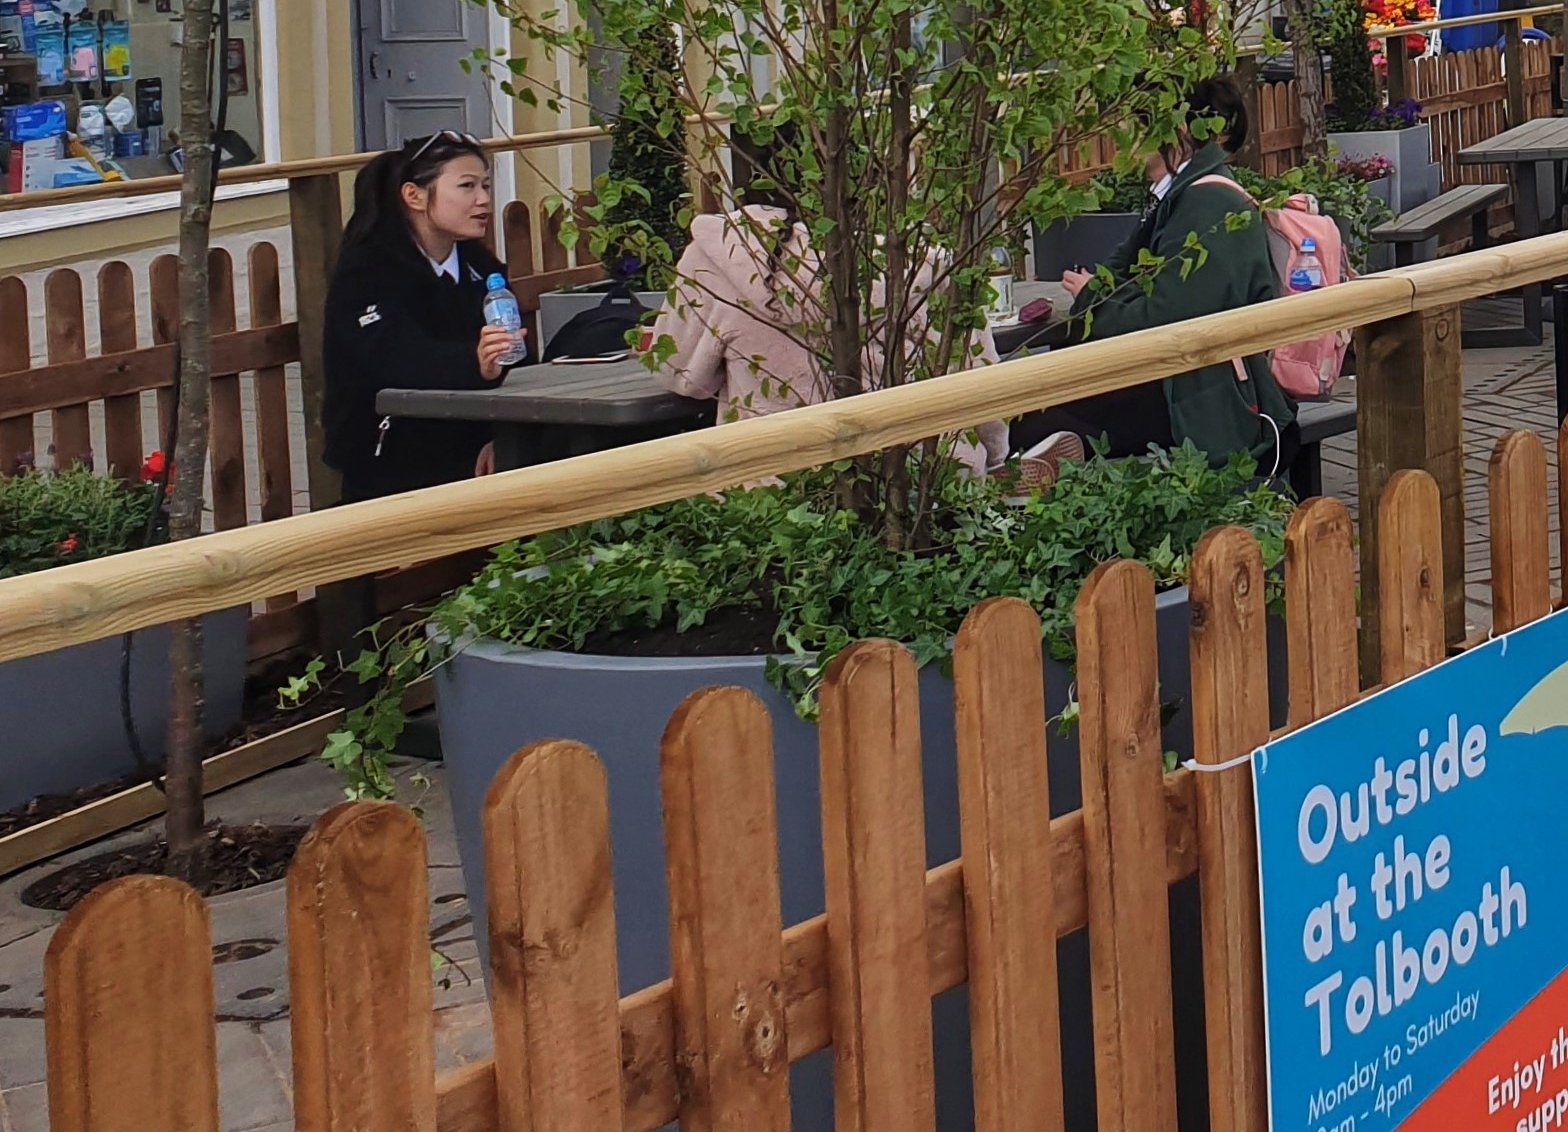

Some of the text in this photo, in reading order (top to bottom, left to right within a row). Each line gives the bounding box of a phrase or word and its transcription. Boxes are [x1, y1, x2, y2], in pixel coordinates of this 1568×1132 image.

[1297, 712, 1487, 864] Outside
[1303, 834, 1451, 963] at the
[1304, 865, 1527, 1057] Tolbooth
[1307, 989, 1480, 1126] Monday to Saturday
[1373, 1073, 1413, 1118] 4pm
[1488, 1053, 1546, 1115] Enjoy
